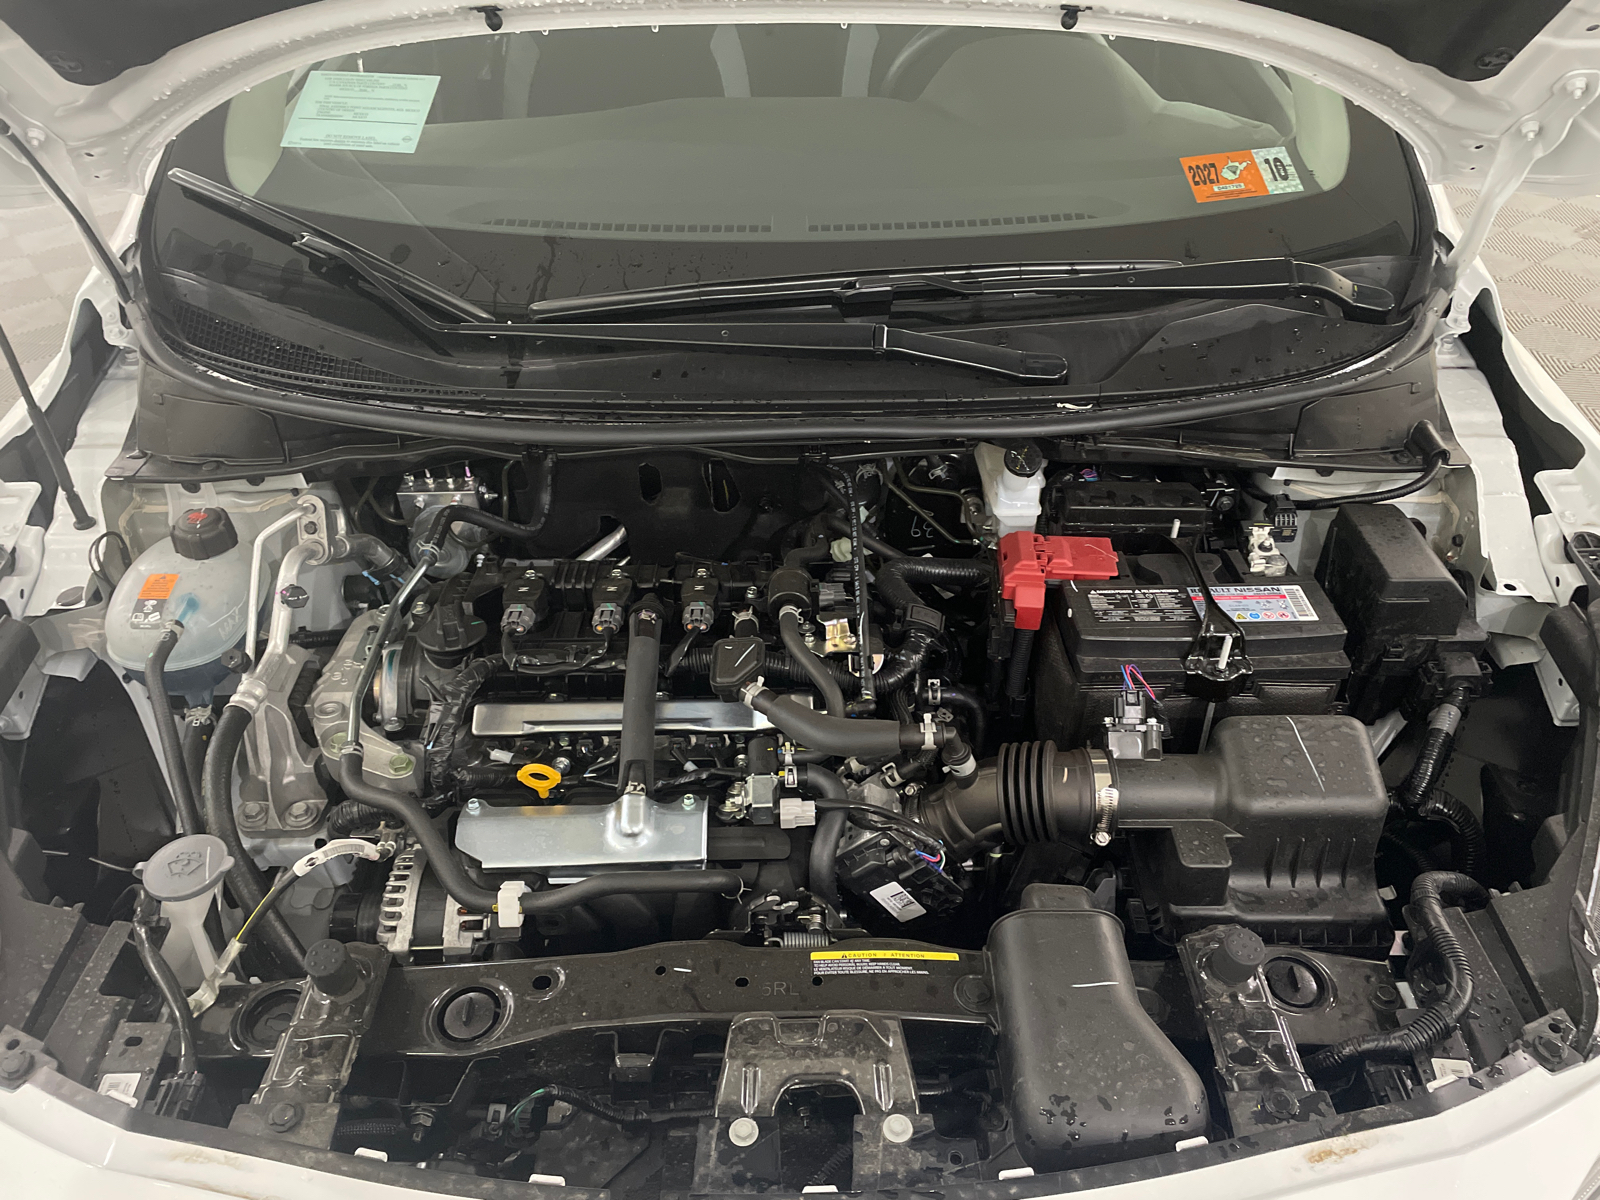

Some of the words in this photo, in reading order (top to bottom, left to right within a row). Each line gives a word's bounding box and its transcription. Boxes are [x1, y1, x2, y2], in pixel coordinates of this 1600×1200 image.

[1188, 163, 1219, 186] 2027
[1264, 157, 1290, 181] 10
[218, 608, 243, 641] MAX
